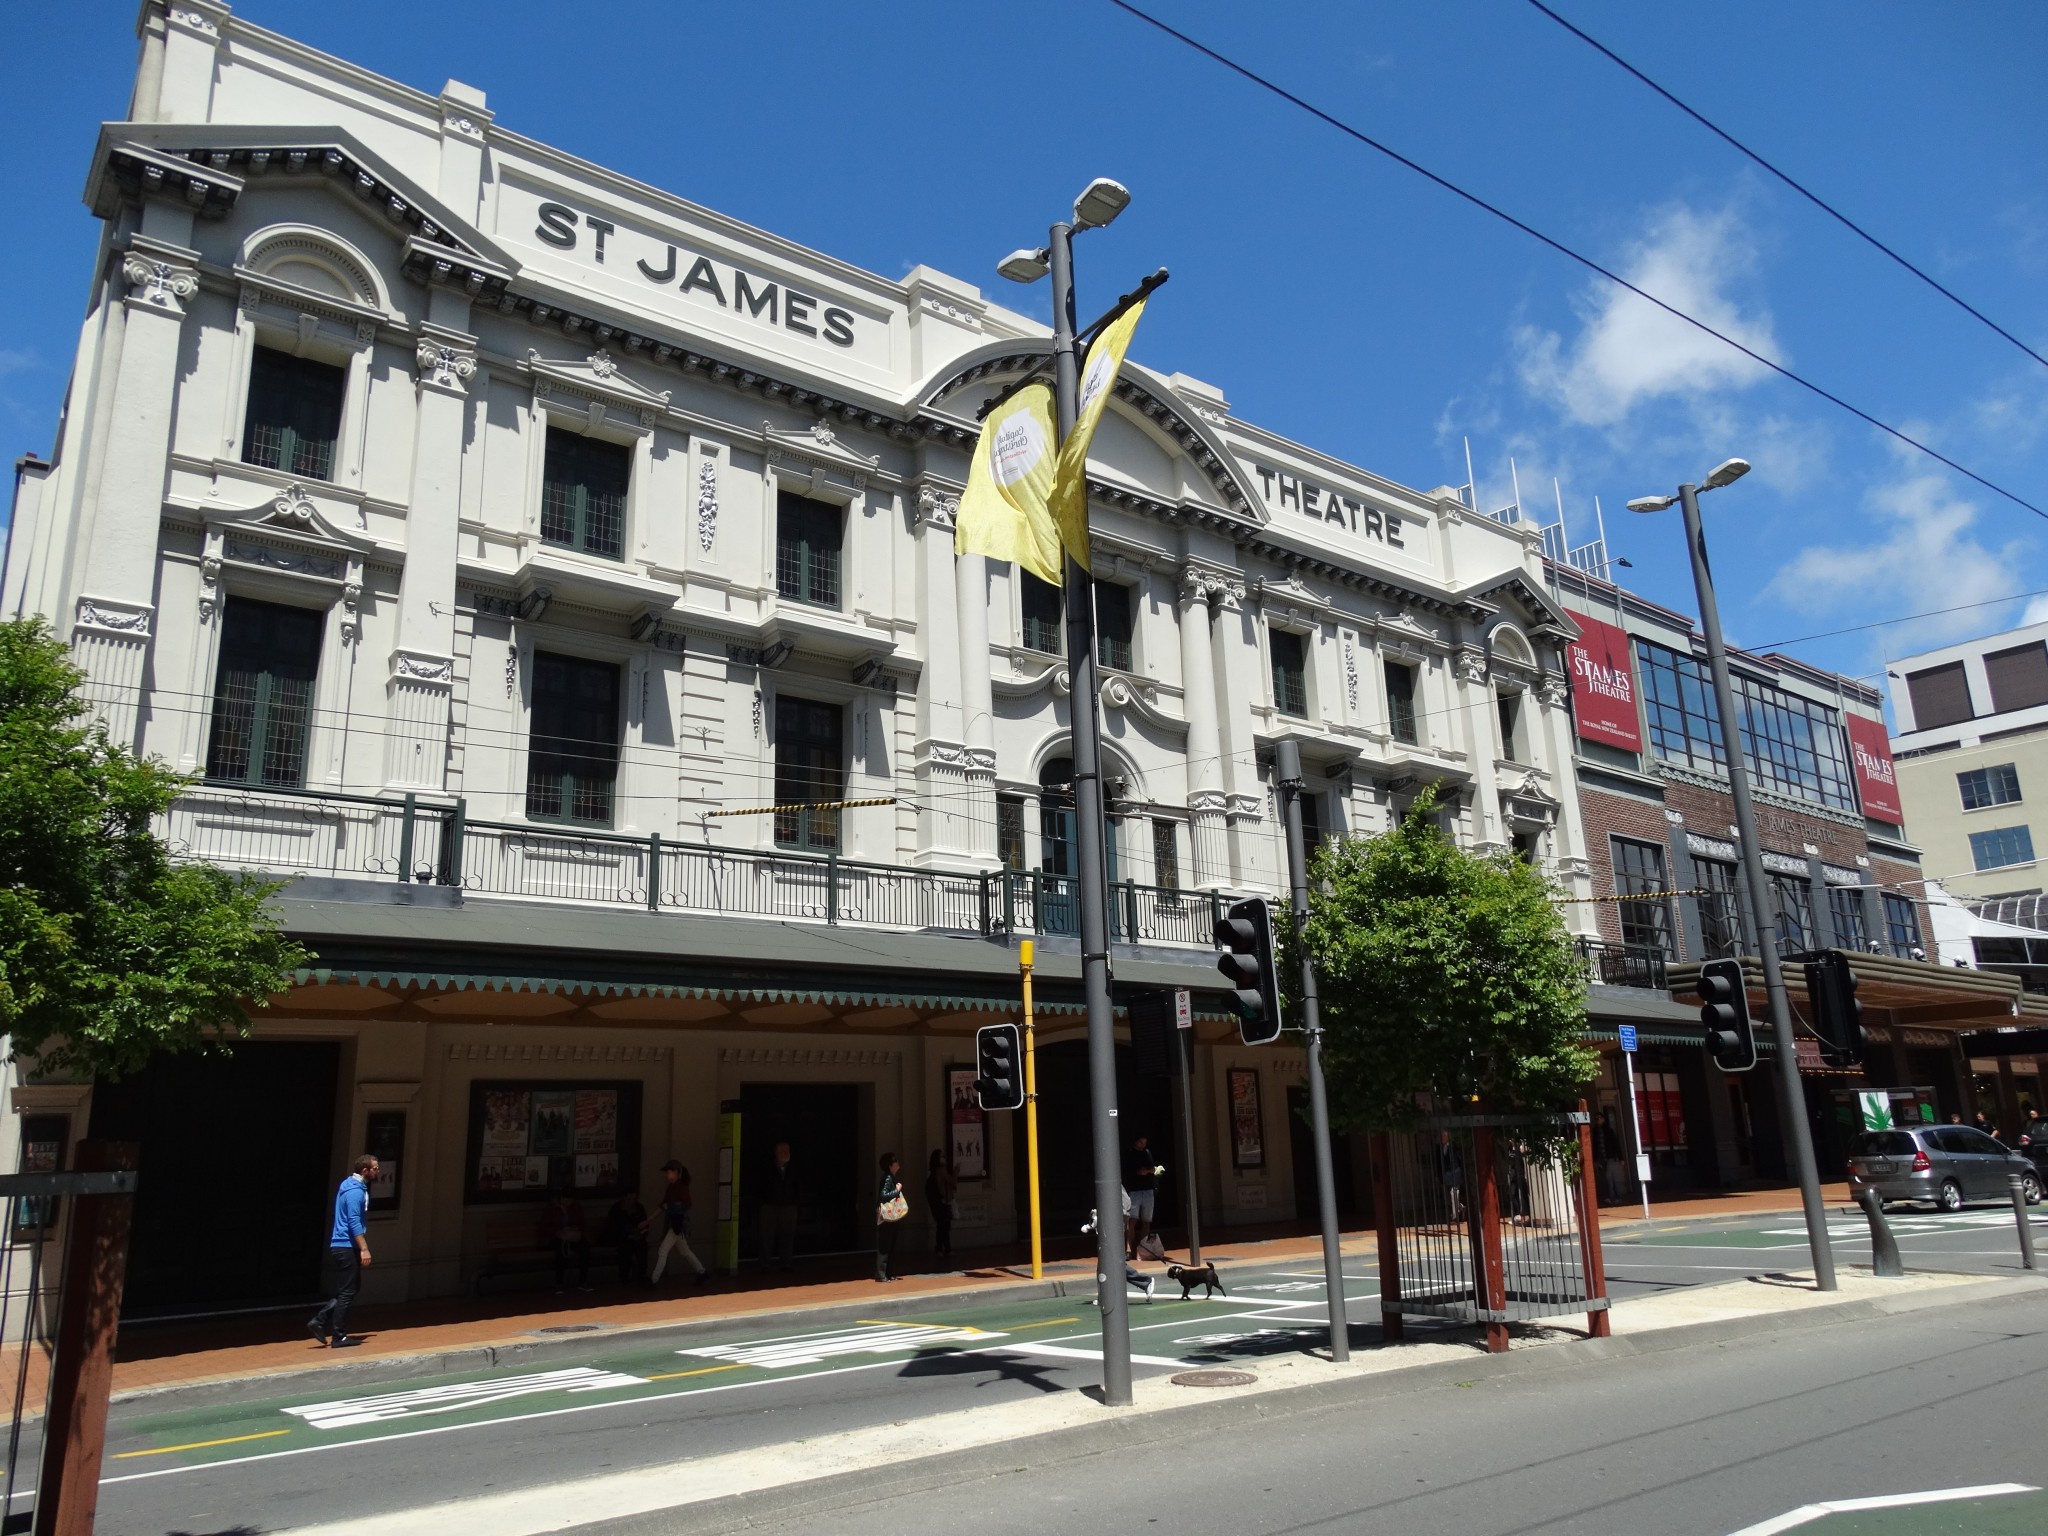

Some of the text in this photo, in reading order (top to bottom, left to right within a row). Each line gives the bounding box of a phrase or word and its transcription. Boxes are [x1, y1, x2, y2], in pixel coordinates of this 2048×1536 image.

[535, 202, 855, 348] ST JAMES
[1255, 464, 1405, 550] THEATRE
[1572, 646, 1589, 660] THE
[1594, 681, 1632, 703] THEATRE
[1853, 741, 1866, 753] THE
[1868, 769, 1894, 786] THEATRE
[1767, 813, 1796, 835] JAMES
[1800, 823, 1839, 846] THEATRE
[279, 1366, 653, 1430] BUS
